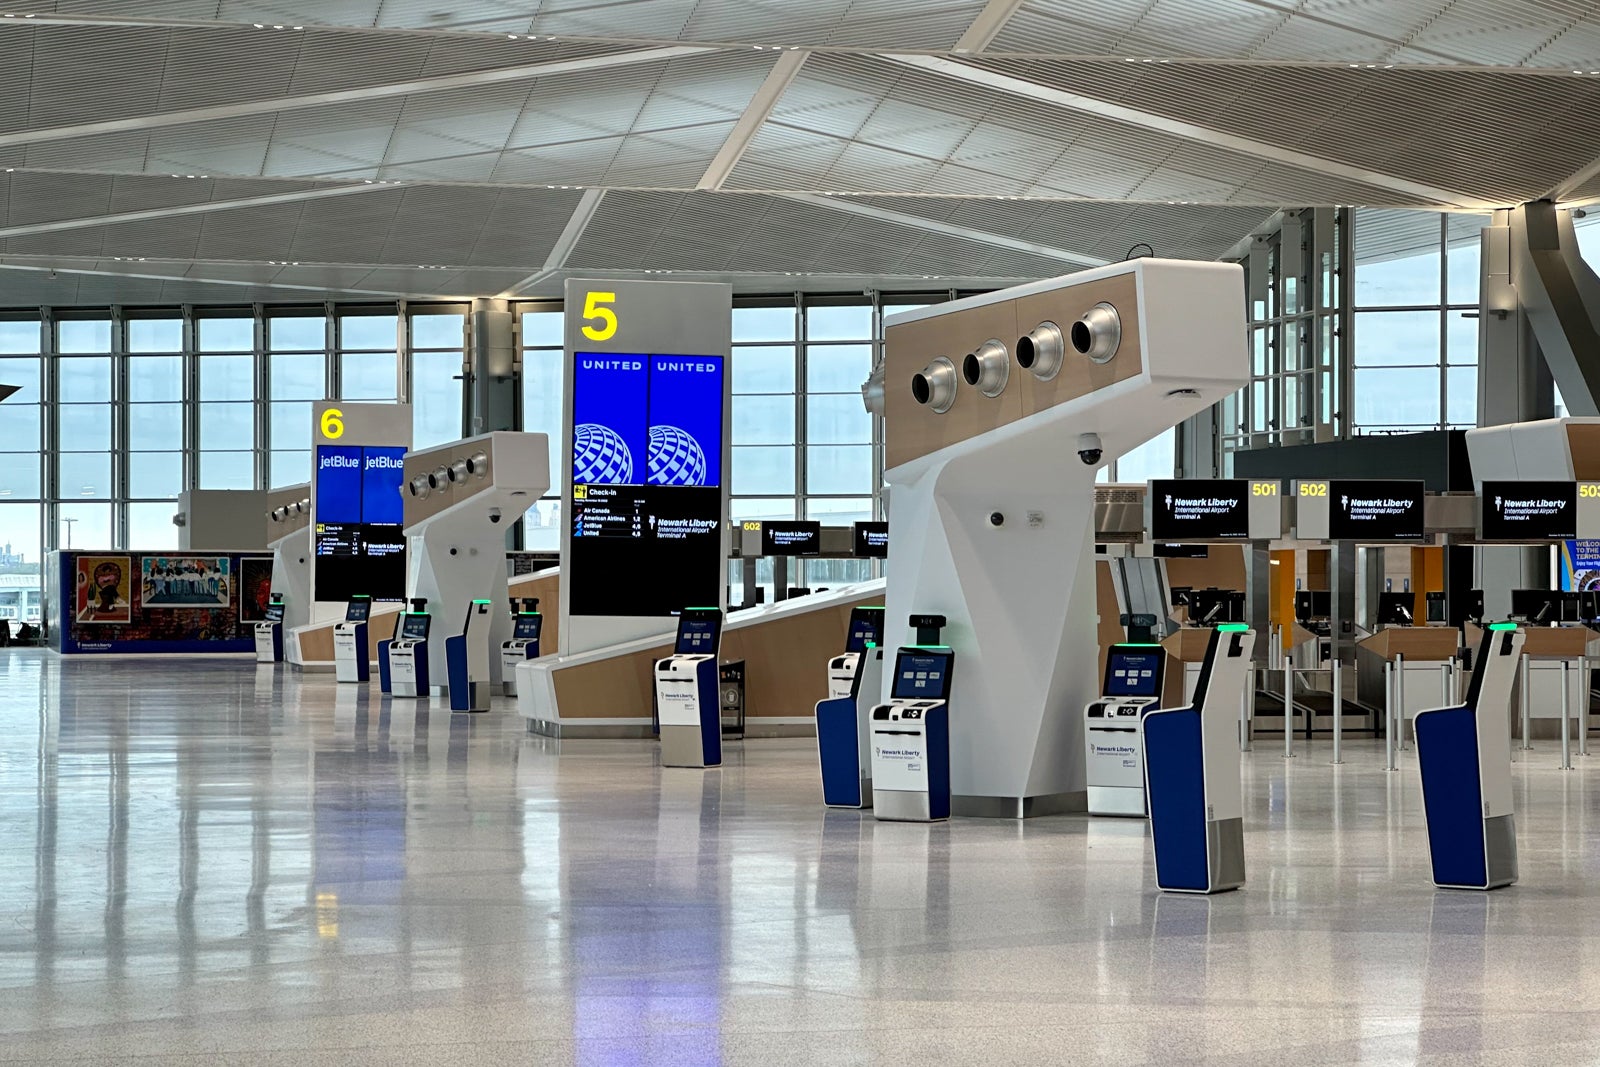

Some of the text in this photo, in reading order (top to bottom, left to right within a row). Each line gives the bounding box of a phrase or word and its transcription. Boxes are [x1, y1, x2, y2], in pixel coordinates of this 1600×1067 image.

[581, 291, 618, 342] 5
[583, 360, 642, 371] UNITED
[657, 362, 716, 373] UNITED
[320, 408, 344, 440] 6
[319, 455, 360, 470] jetBlue
[364, 456, 404, 471] jetBlue
[589, 488, 617, 496] Check-in
[1252, 483, 1277, 497] 501
[1300, 483, 1327, 497] 502
[1174, 498, 1238, 508] Newark Liberty
[1350, 499, 1413, 509] Newark Liberty
[1504, 499, 1567, 509] Newark Liberty
[1175, 506, 1211, 514] International
[658, 518, 718, 529] Newark Liberty
[743, 522, 760, 531] 602
